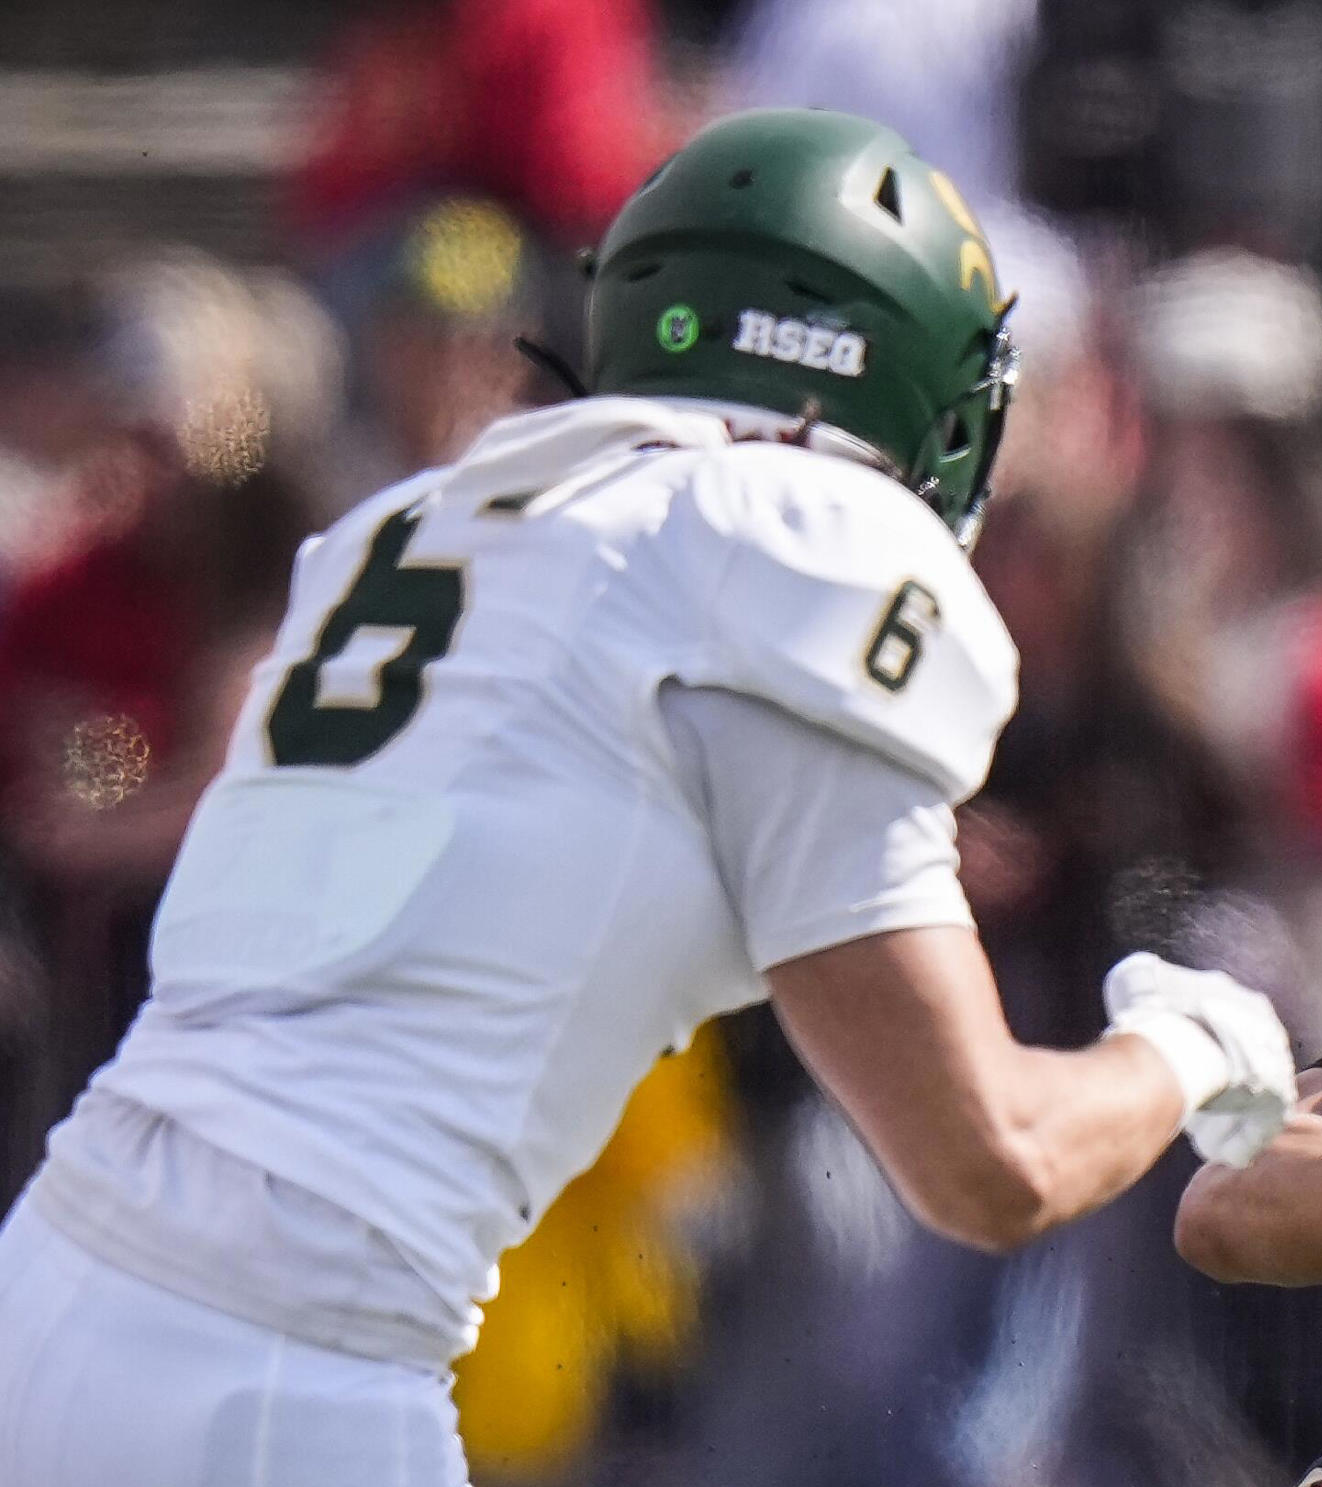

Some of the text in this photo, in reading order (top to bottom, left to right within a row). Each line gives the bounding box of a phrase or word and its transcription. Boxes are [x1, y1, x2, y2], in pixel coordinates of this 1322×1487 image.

[732, 308, 867, 378] RSEQ
[263, 490, 545, 768] 6
[861, 577, 943, 695] 6
